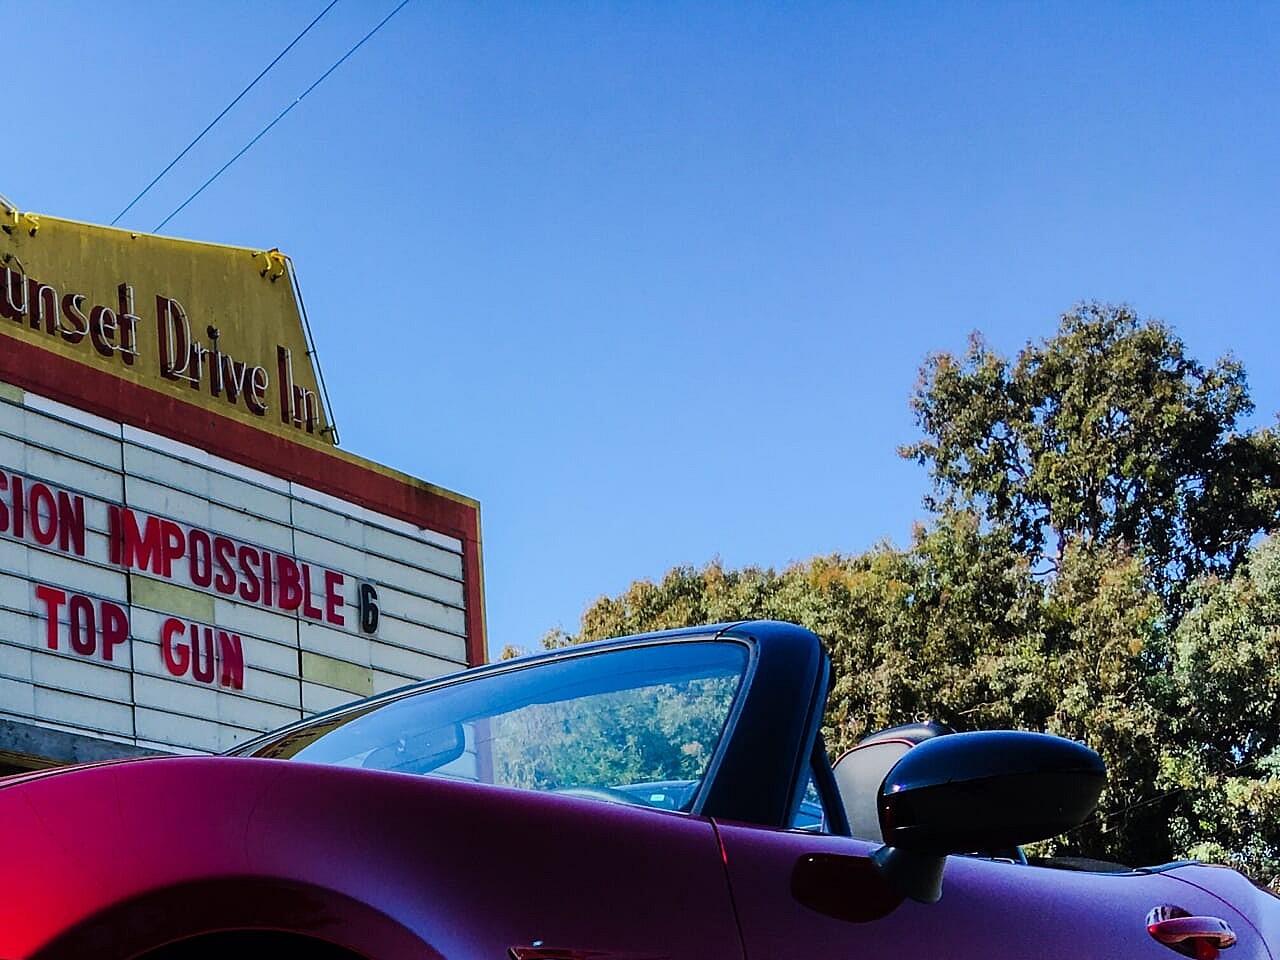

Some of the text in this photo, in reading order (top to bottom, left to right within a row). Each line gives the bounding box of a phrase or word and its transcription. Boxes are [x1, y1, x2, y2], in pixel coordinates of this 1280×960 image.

[156, 294, 269, 416] Drive
[276, 345, 320, 433] In
[109, 505, 344, 627] IMPOSSIBLE
[359, 583, 380, 634] 6
[36, 585, 244, 690] TOP GUN
